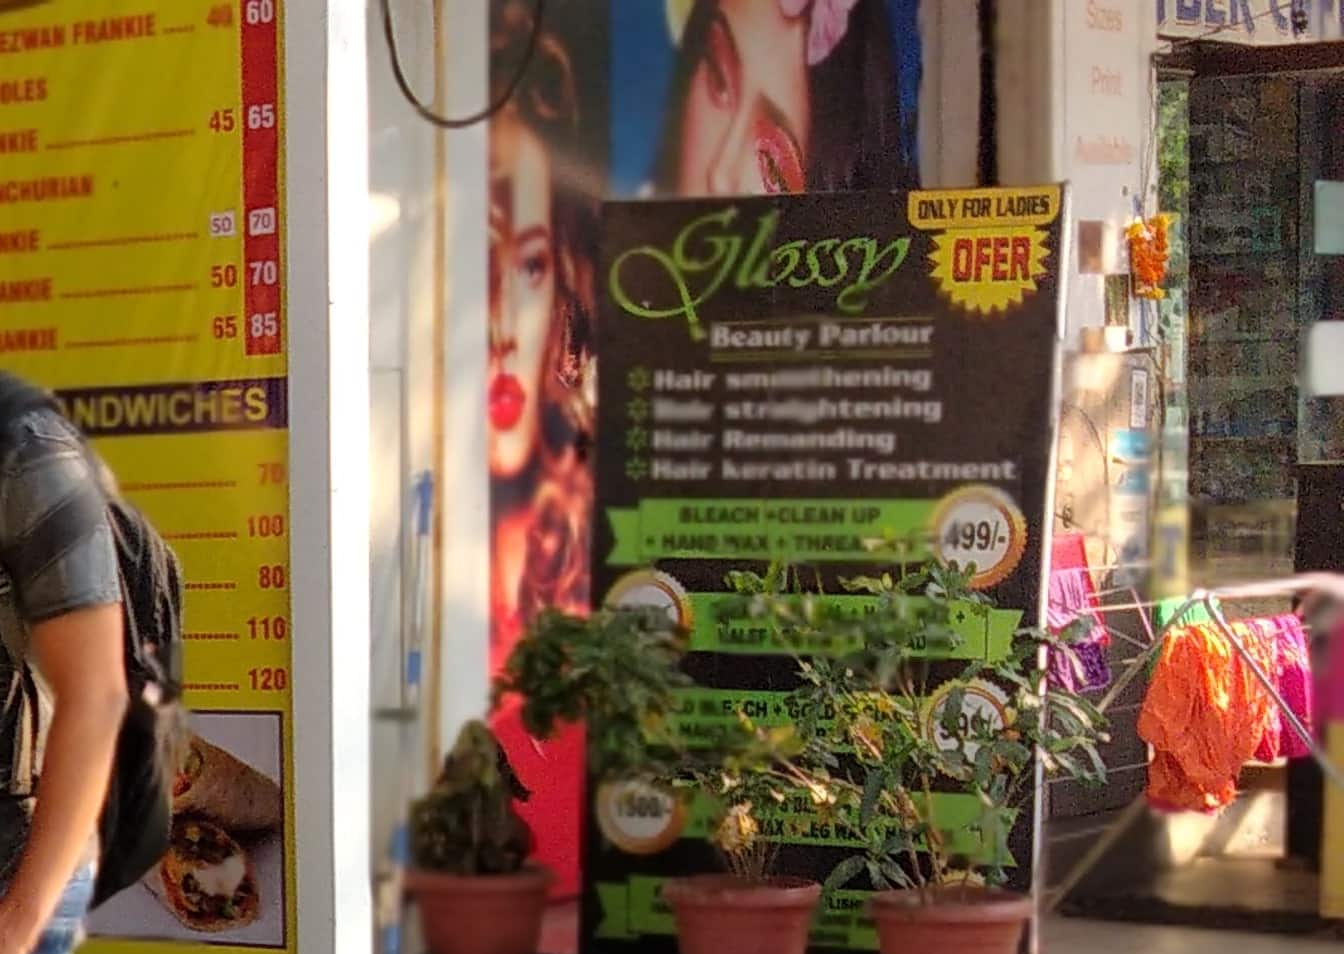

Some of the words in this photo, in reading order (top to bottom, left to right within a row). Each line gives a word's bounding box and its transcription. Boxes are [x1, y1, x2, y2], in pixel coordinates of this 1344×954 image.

[72, 13, 157, 46] FRANKIE
[245, 0, 274, 24] 60
[209, 108, 234, 133] 45
[247, 103, 276, 130] 65
[917, 196, 955, 220] ONLY
[961, 195, 991, 217] FOR
[996, 194, 1050, 216] LADIES
[212, 215, 233, 235] 50
[252, 211, 272, 231] 70
[952, 235, 1031, 283] OFER
[211, 264, 237, 288] 50
[250, 260, 277, 286] 70
[609, 206, 912, 341] Glossy
[213, 314, 237, 339] 65
[250, 313, 278, 337] 85
[712, 324, 810, 349] Beauty
[820, 322, 935, 345] Parlour
[653, 370, 713, 391] Hair
[721, 459, 836, 480] keratin
[846, 459, 1018, 480] Treatment
[247, 515, 285, 539] 100
[678, 506, 759, 525] BLEACH
[852, 506, 881, 524] UP
[259, 565, 286, 590] 80
[248, 615, 287, 640] 110
[248, 667, 287, 691] 120
